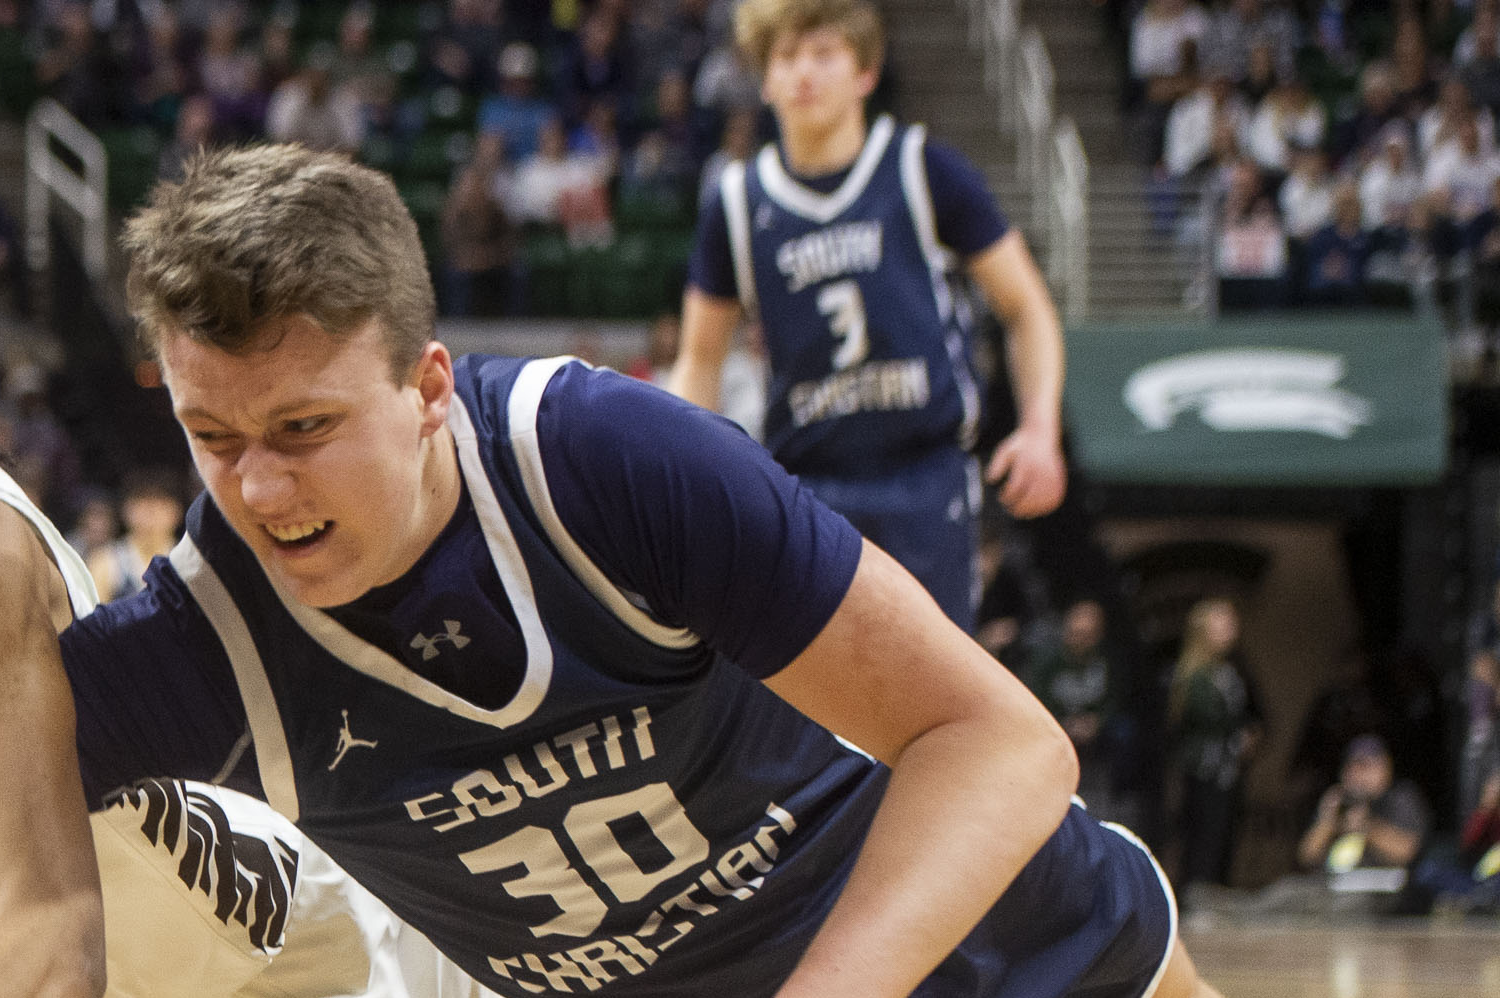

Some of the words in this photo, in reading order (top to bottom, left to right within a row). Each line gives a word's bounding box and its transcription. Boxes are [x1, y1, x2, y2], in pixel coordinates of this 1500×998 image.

[817, 279, 868, 370] 3
[404, 706, 656, 832] SOUTH
[458, 781, 710, 938] 30
